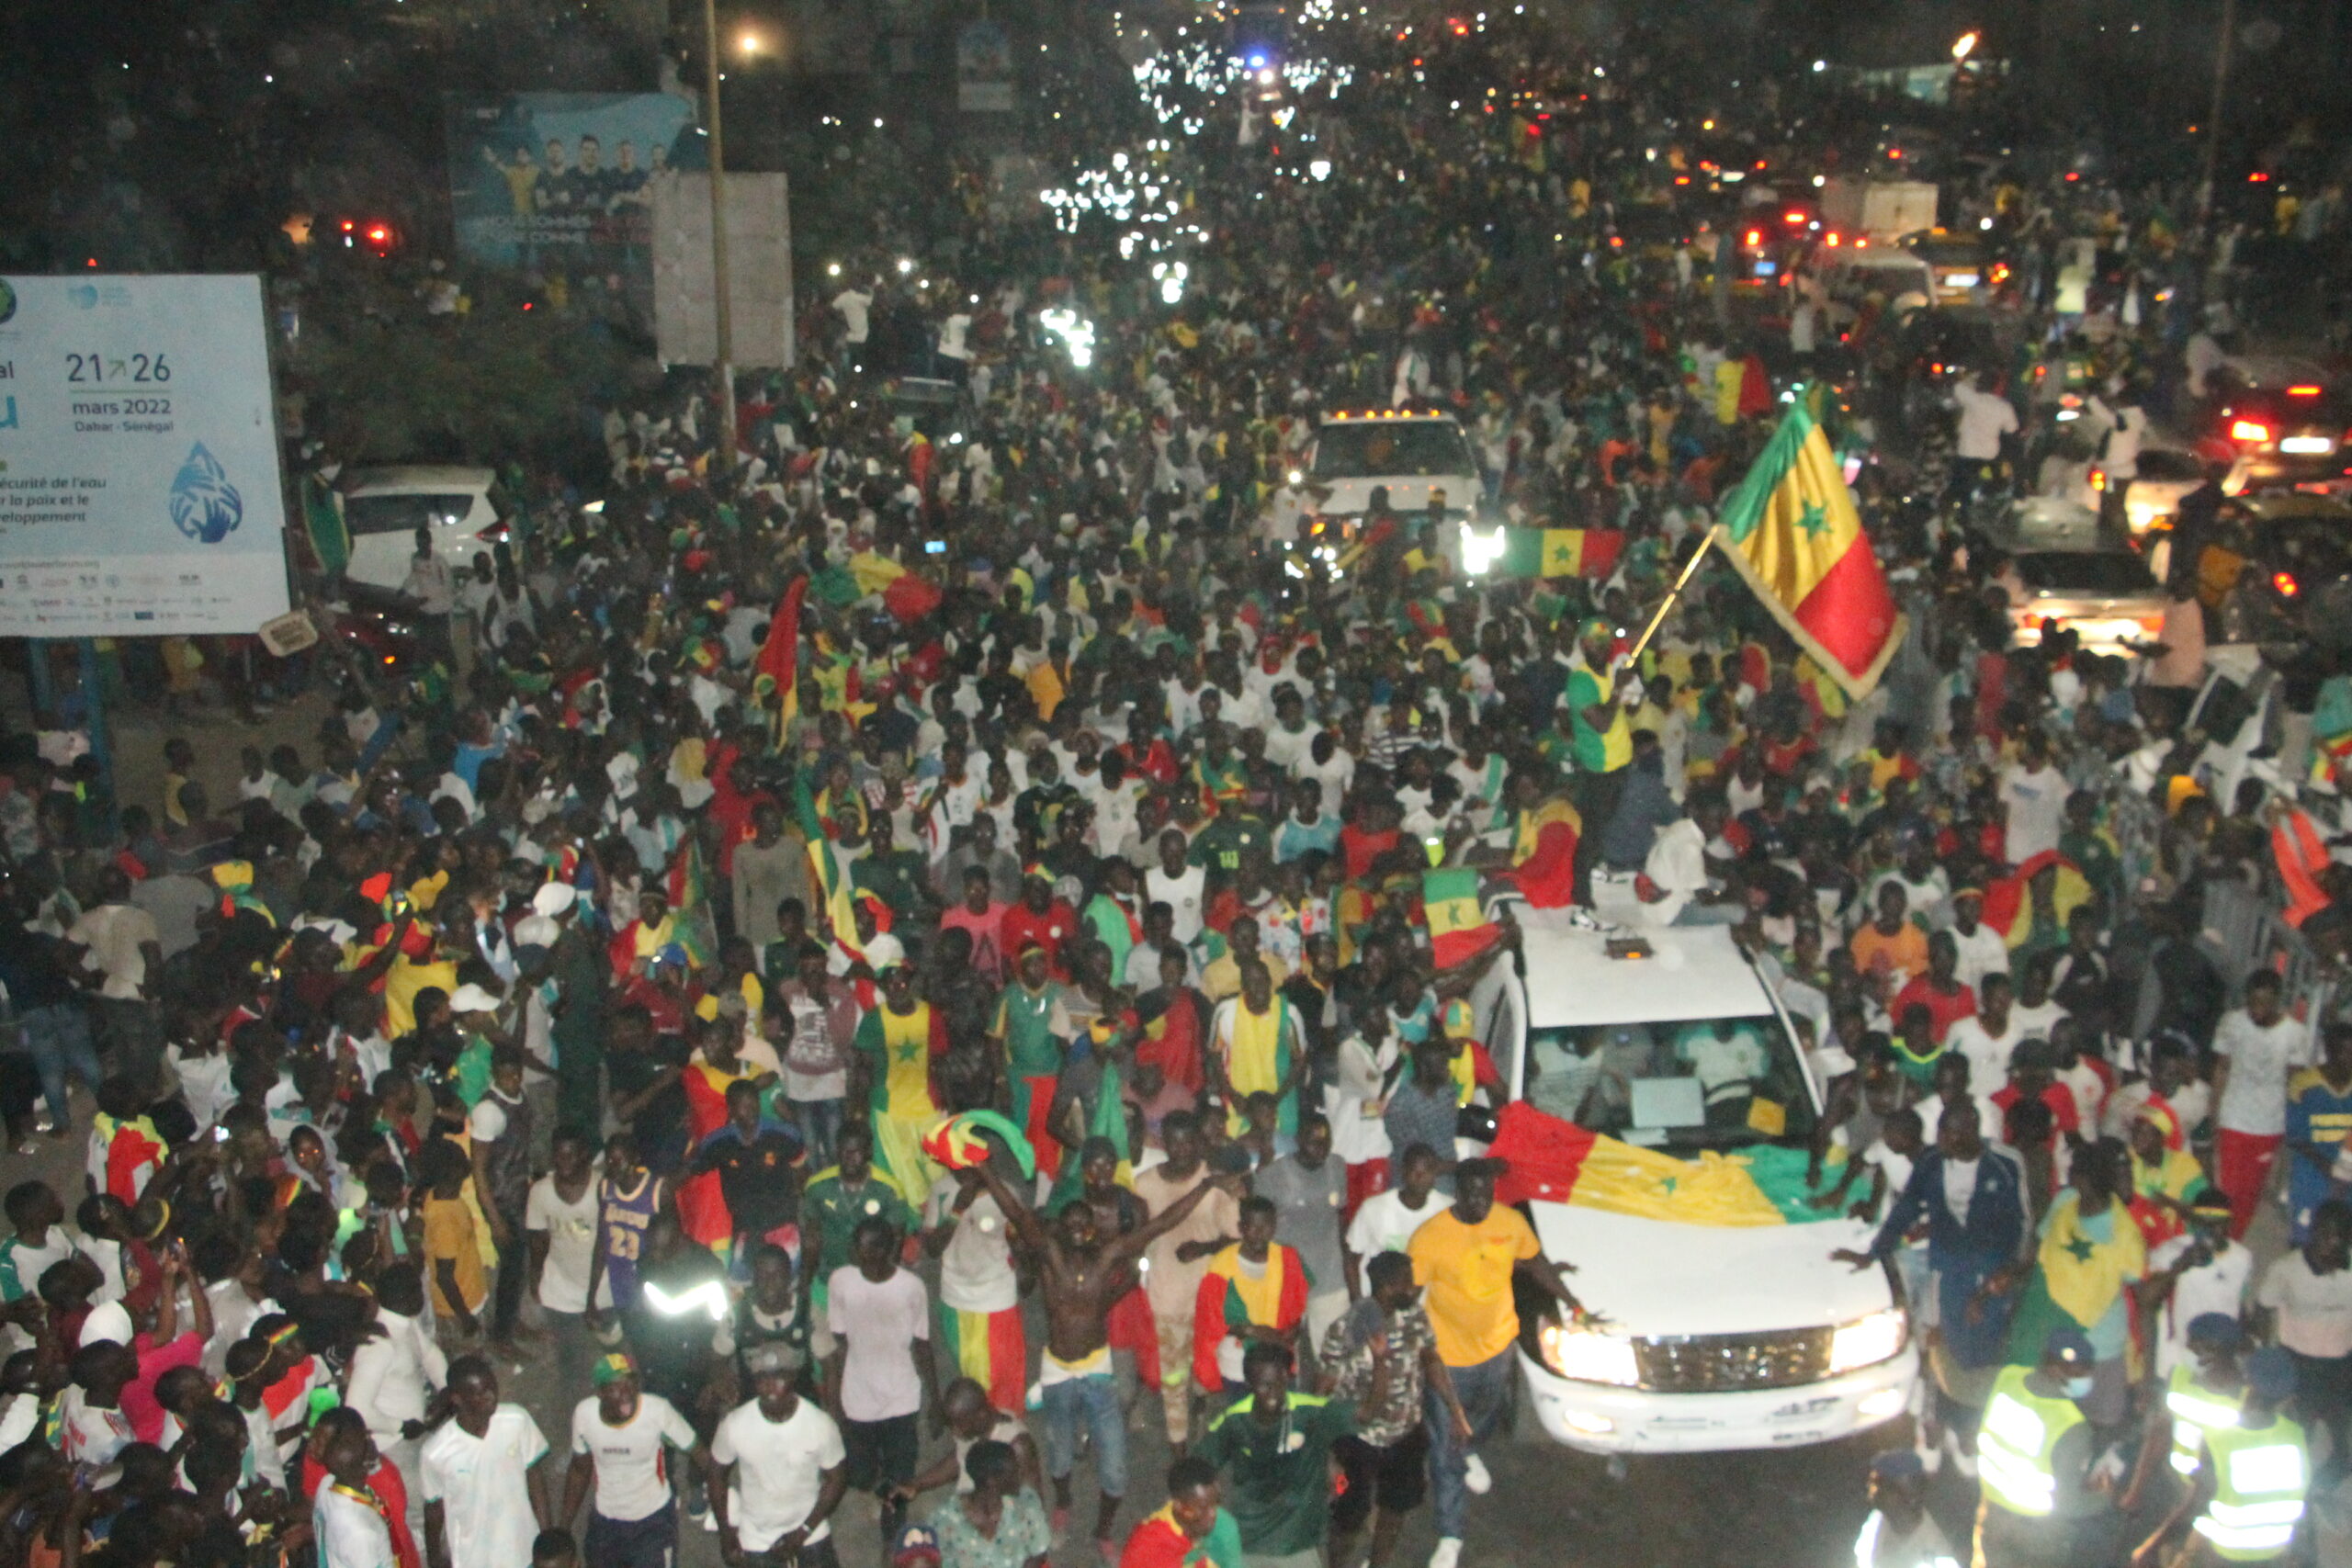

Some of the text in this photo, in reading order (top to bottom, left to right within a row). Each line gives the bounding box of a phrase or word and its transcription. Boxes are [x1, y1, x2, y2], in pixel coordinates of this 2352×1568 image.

[66, 353, 171, 382] 21 26
[73, 399, 171, 414] mars 2022
[74, 421, 114, 433] Dakar
[51, 478, 69, 489] de
[10, 494, 23, 506] la
[27, 495, 56, 509] paix
[60, 496, 74, 506] et
[77, 494, 90, 506] le
[0, 512, 86, 525] eloppement
